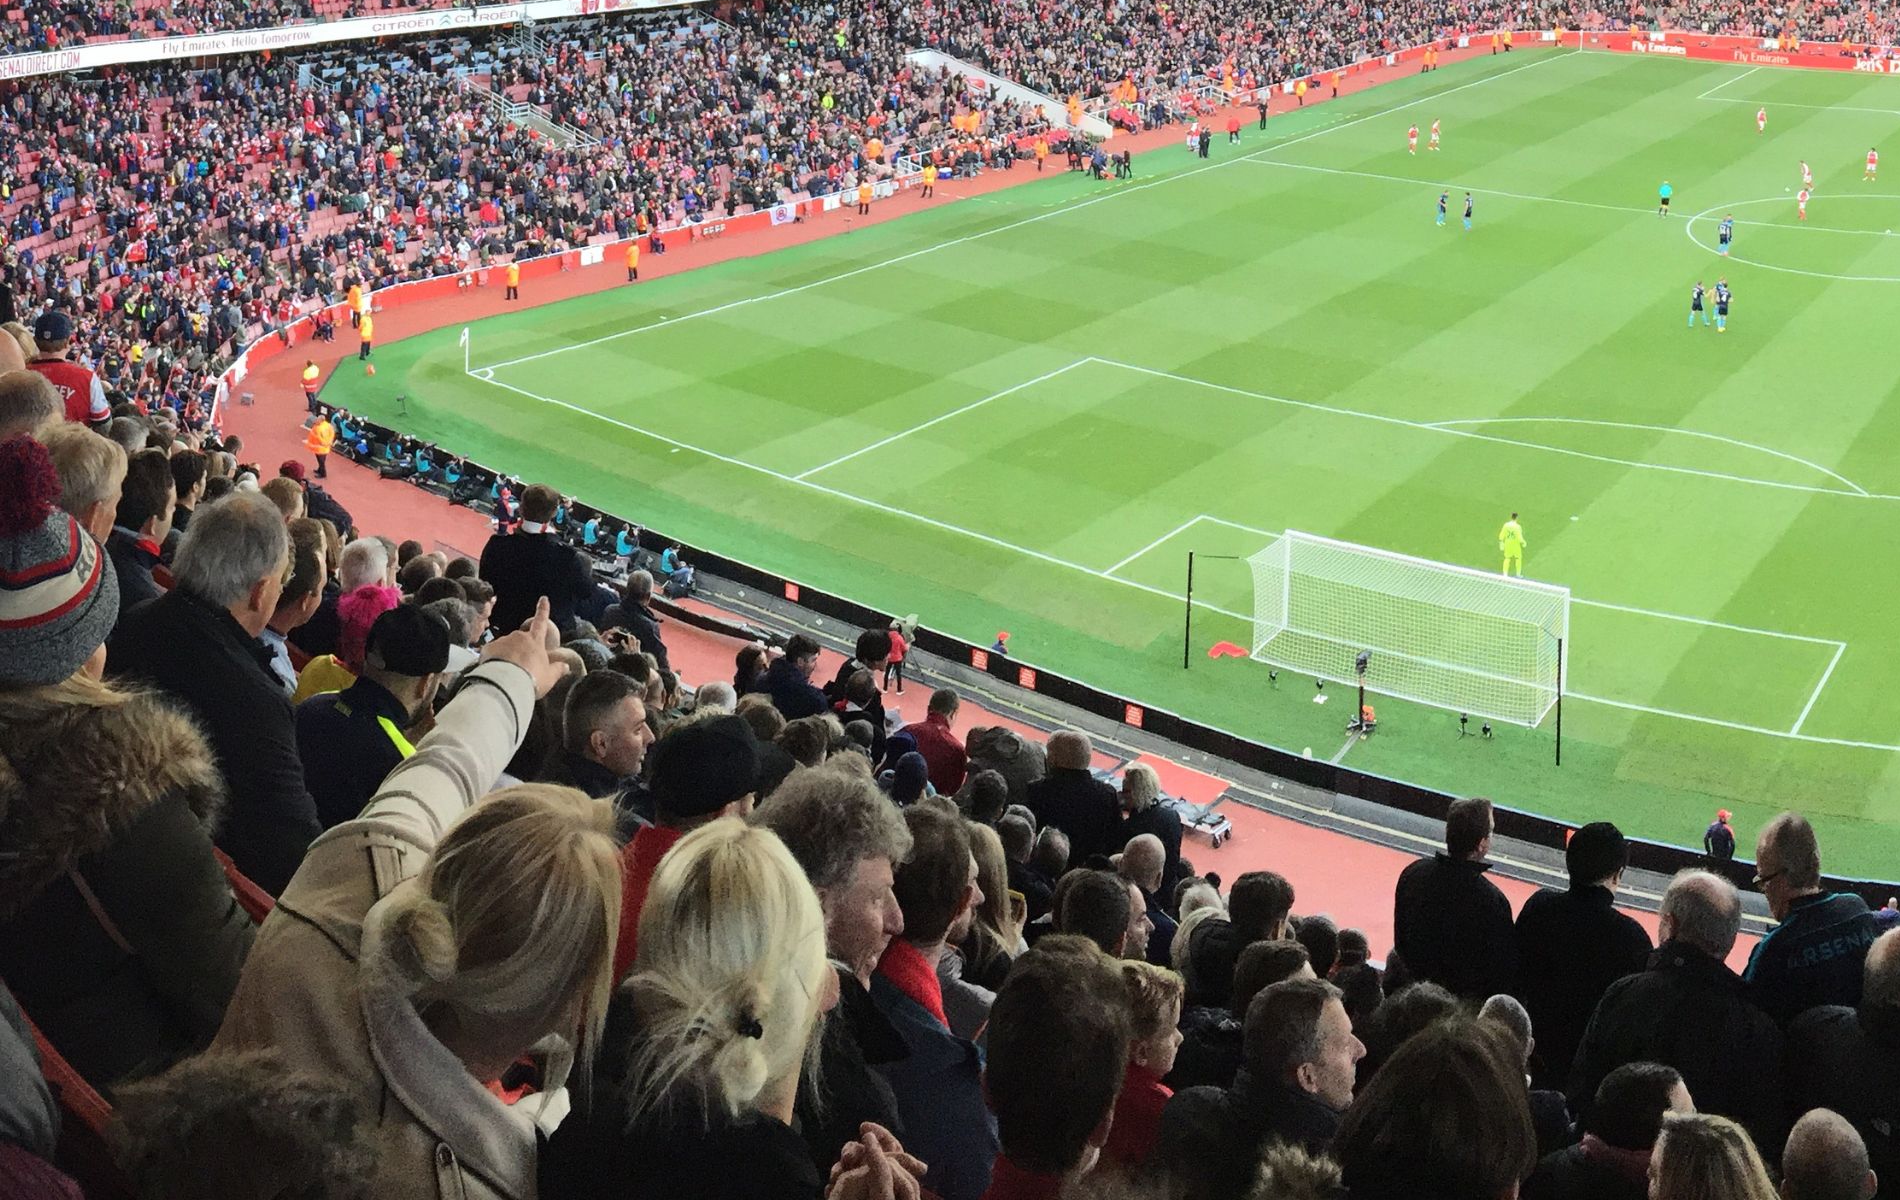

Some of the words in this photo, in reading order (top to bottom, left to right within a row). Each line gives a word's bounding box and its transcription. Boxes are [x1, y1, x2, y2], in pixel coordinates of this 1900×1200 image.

[162, 41, 179, 55] Fly
[231, 36, 259, 49] Hello
[261, 30, 312, 45] Tomorrow
[1632, 40, 1647, 53] Fly
[1648, 42, 1687, 55] Emirates
[1733, 51, 1749, 63] Fly
[1750, 52, 1790, 65] Emirates
